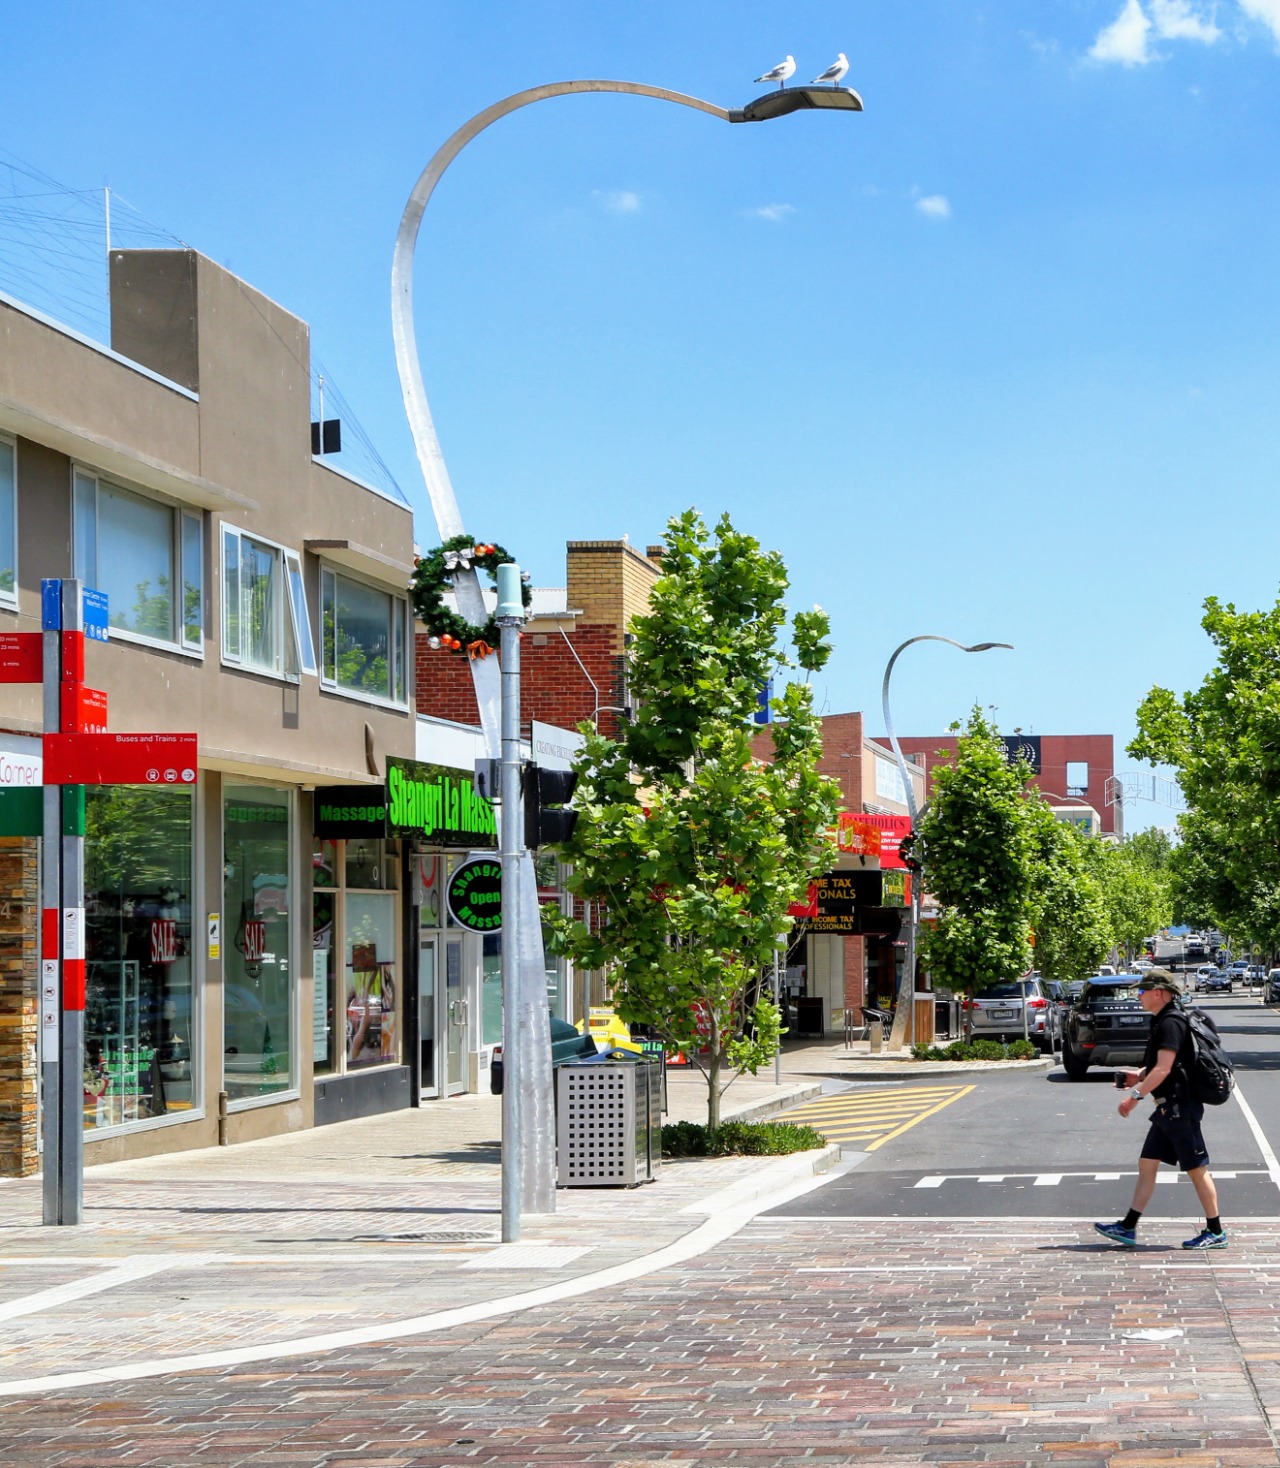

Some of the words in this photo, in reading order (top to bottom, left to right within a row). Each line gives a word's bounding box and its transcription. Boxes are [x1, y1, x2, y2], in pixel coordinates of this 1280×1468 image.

[389, 766, 443, 835] Shangri
[445, 777, 459, 830] La
[461, 779, 497, 834] Massa
[320, 805, 385, 822] Massage
[833, 878, 852, 888] TAX
[470, 891, 501, 905] Open
[457, 906, 503, 927] Massa
[812, 915, 838, 923] INCOME
[840, 915, 854, 923] TAX
[151, 922, 176, 962] SALE
[245, 923, 265, 960] SALE
